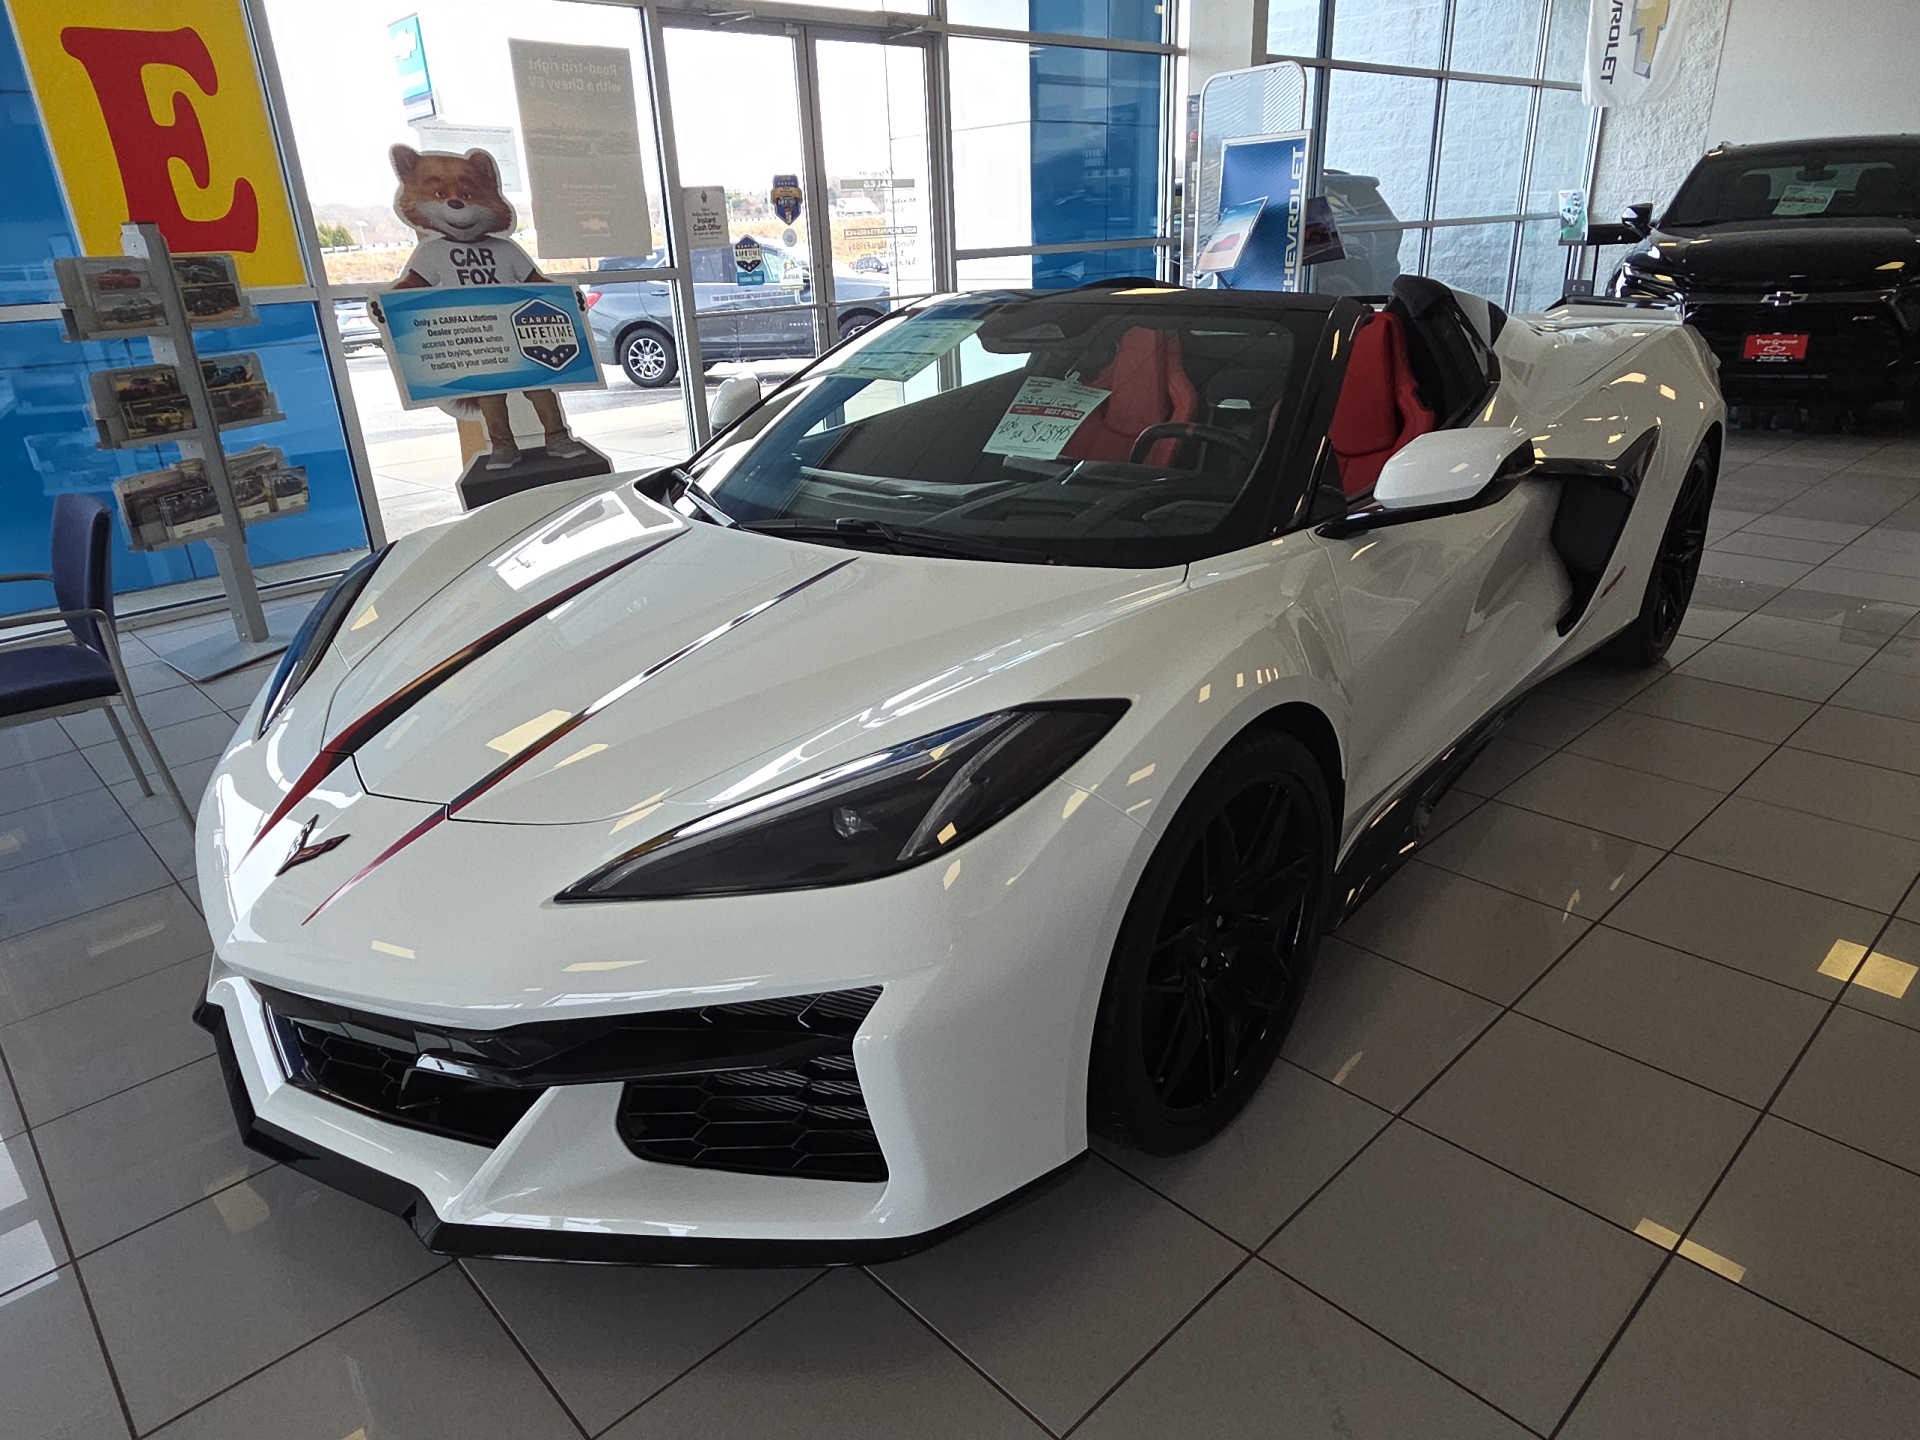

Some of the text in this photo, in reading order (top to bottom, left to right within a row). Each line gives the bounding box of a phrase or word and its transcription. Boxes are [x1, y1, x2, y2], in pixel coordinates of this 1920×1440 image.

[61, 26, 259, 253] E
[1283, 146, 1305, 292] HEVROLET
[450, 248, 496, 267] CAR
[456, 268, 501, 285] FOX
[413, 318, 431, 327] Only
[439, 315, 468, 325] CARFAX
[469, 314, 498, 323] Lifetime
[521, 315, 565, 324] CARFAX
[427, 328, 451, 337] Dealer
[453, 326, 482, 335] provides
[517, 325, 574, 339] LIFETIME
[422, 340, 446, 349] access
[455, 336, 484, 345] CARFAX
[420, 353, 433, 361] you
[434, 351, 446, 359] are
[448, 348, 472, 358] buying,
[473, 346, 502, 355] servicing
[431, 361, 456, 370] trading
[465, 359, 480, 368] your
[1044, 407, 1062, 416] BEST
[1060, 409, 1083, 419] PRICE
